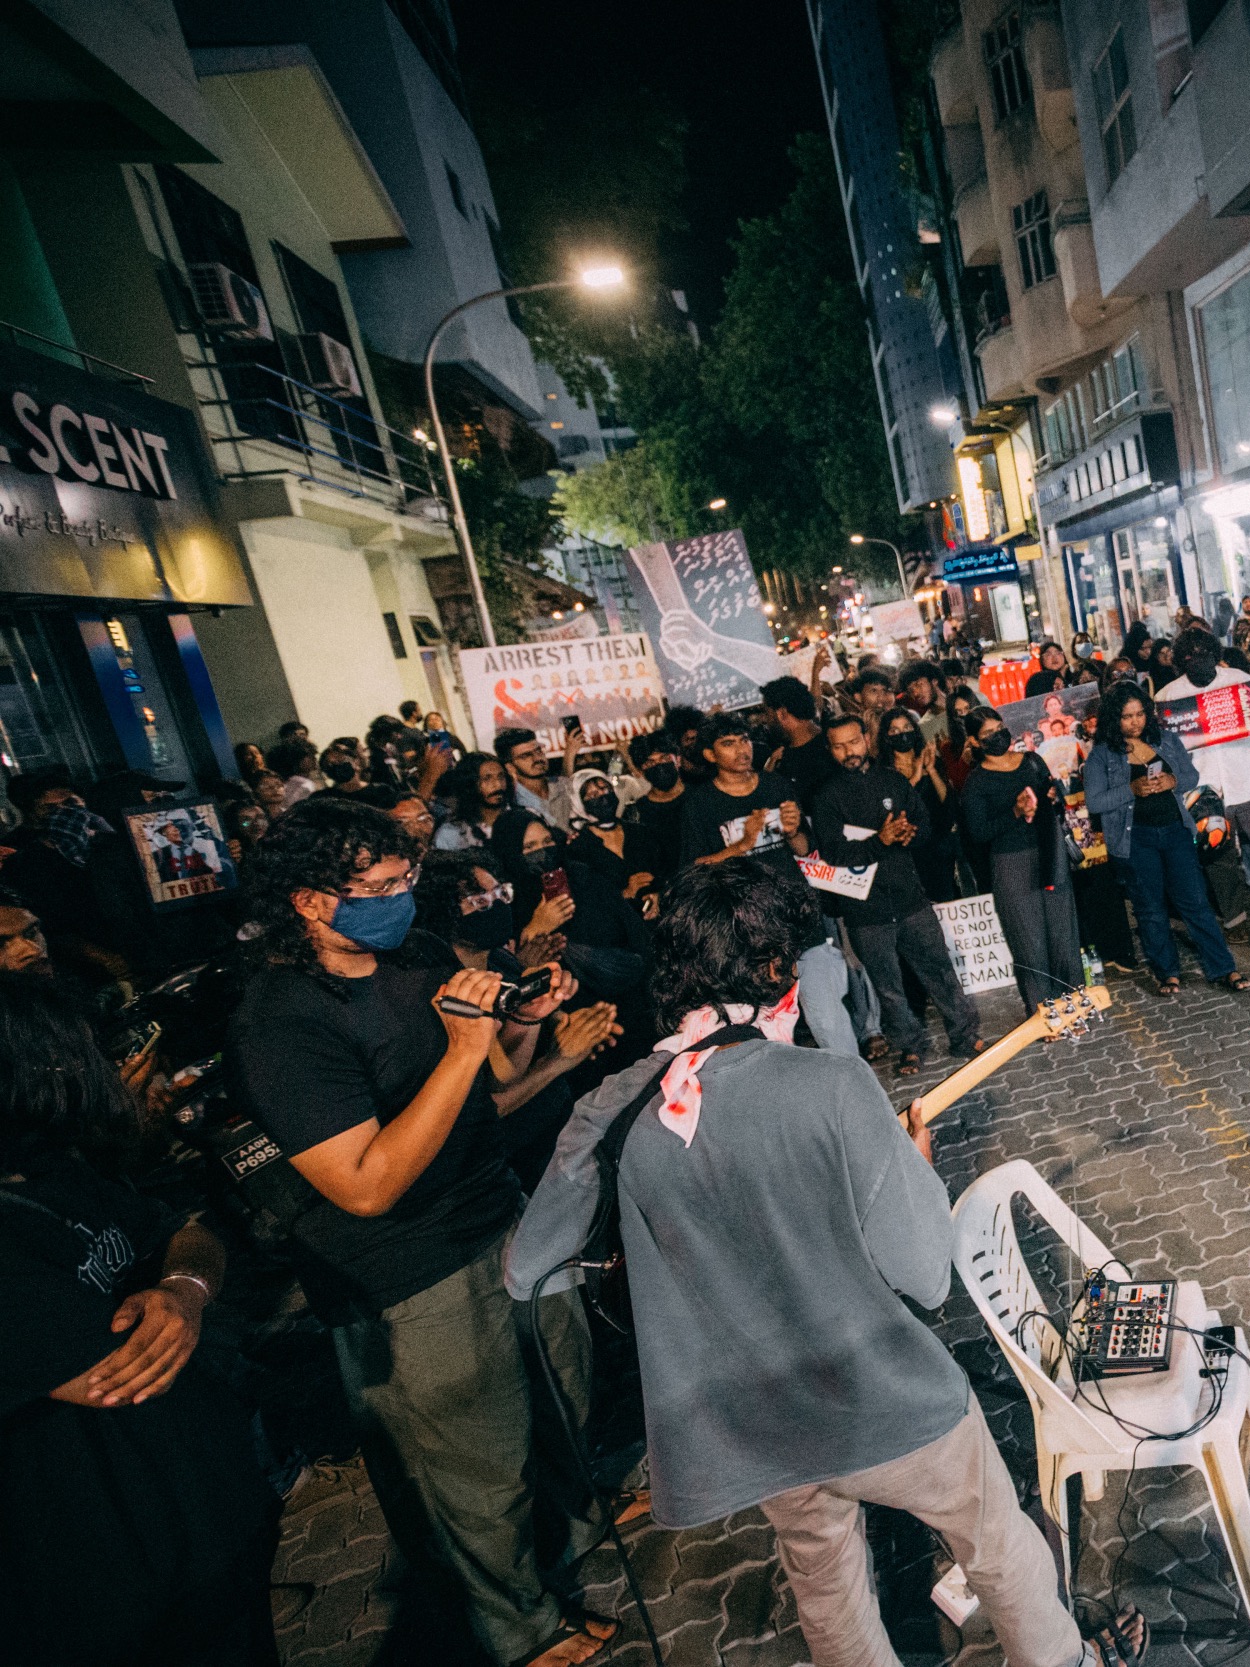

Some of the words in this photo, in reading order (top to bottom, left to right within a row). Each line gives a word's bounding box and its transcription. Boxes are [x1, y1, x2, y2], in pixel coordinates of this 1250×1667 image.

[12, 391, 178, 500] SCENT
[484, 644, 574, 673] ARREST
[584, 637, 647, 663] THEM
[936, 900, 994, 921] JUSTIC
[953, 924, 965, 935] IS
[968, 918, 994, 933] NOT
[954, 932, 1007, 951] REQUES
[955, 955, 967, 967] IT
[973, 952, 985, 964] IS
[988, 950, 999, 962] A
[959, 963, 1014, 988] EMAN
